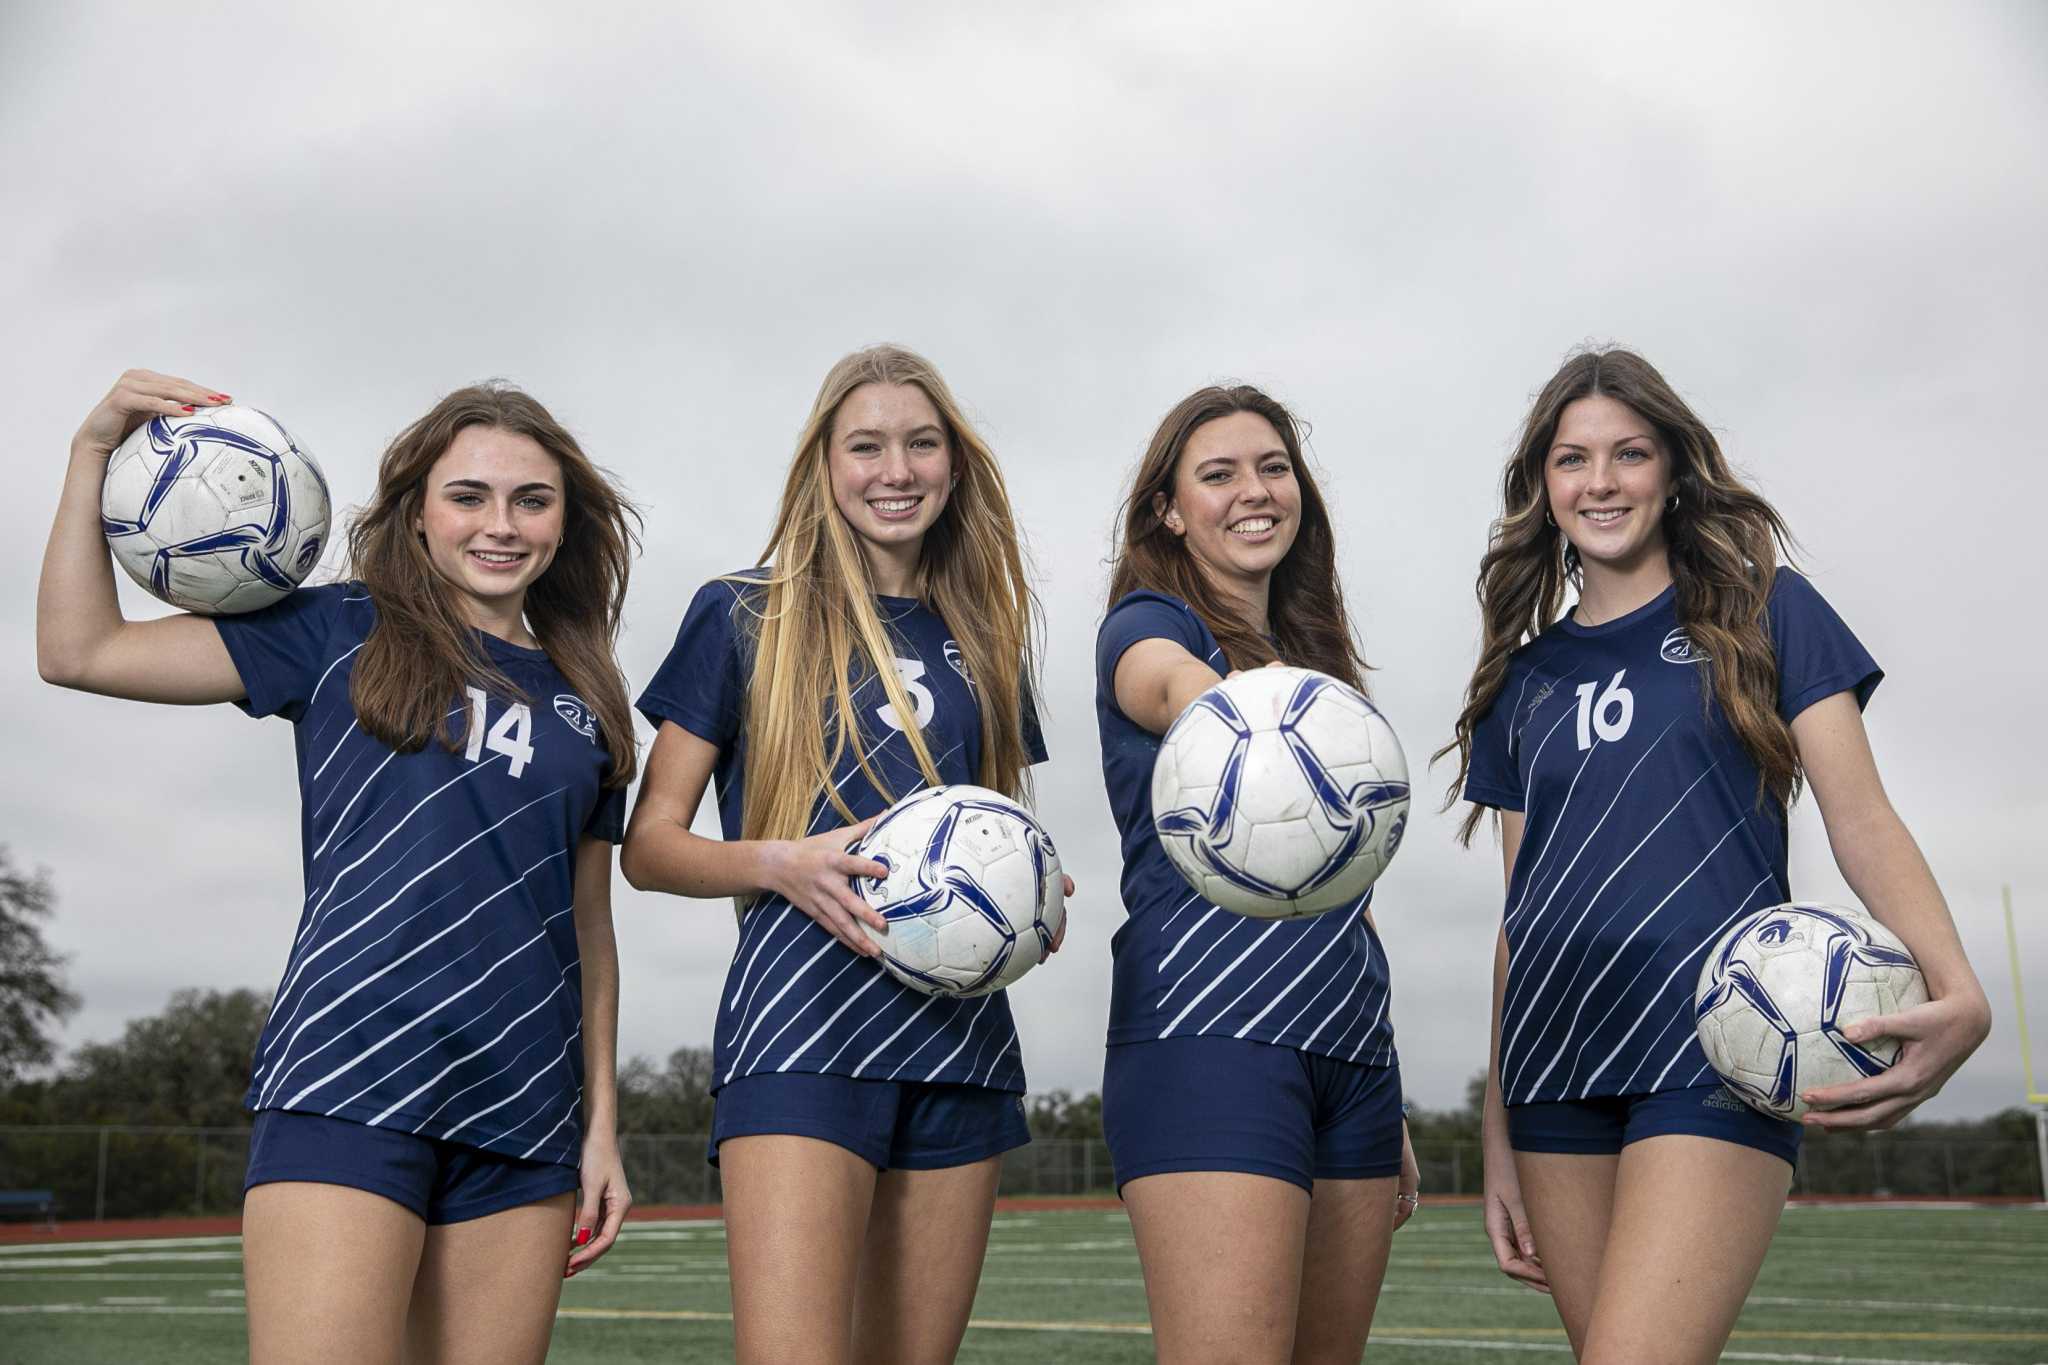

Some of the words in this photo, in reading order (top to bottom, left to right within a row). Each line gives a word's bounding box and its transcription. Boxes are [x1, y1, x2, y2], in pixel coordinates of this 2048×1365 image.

[464, 685, 534, 779] 14
[1575, 668, 1634, 751] 16
[1702, 1098, 1745, 1113] adidas
